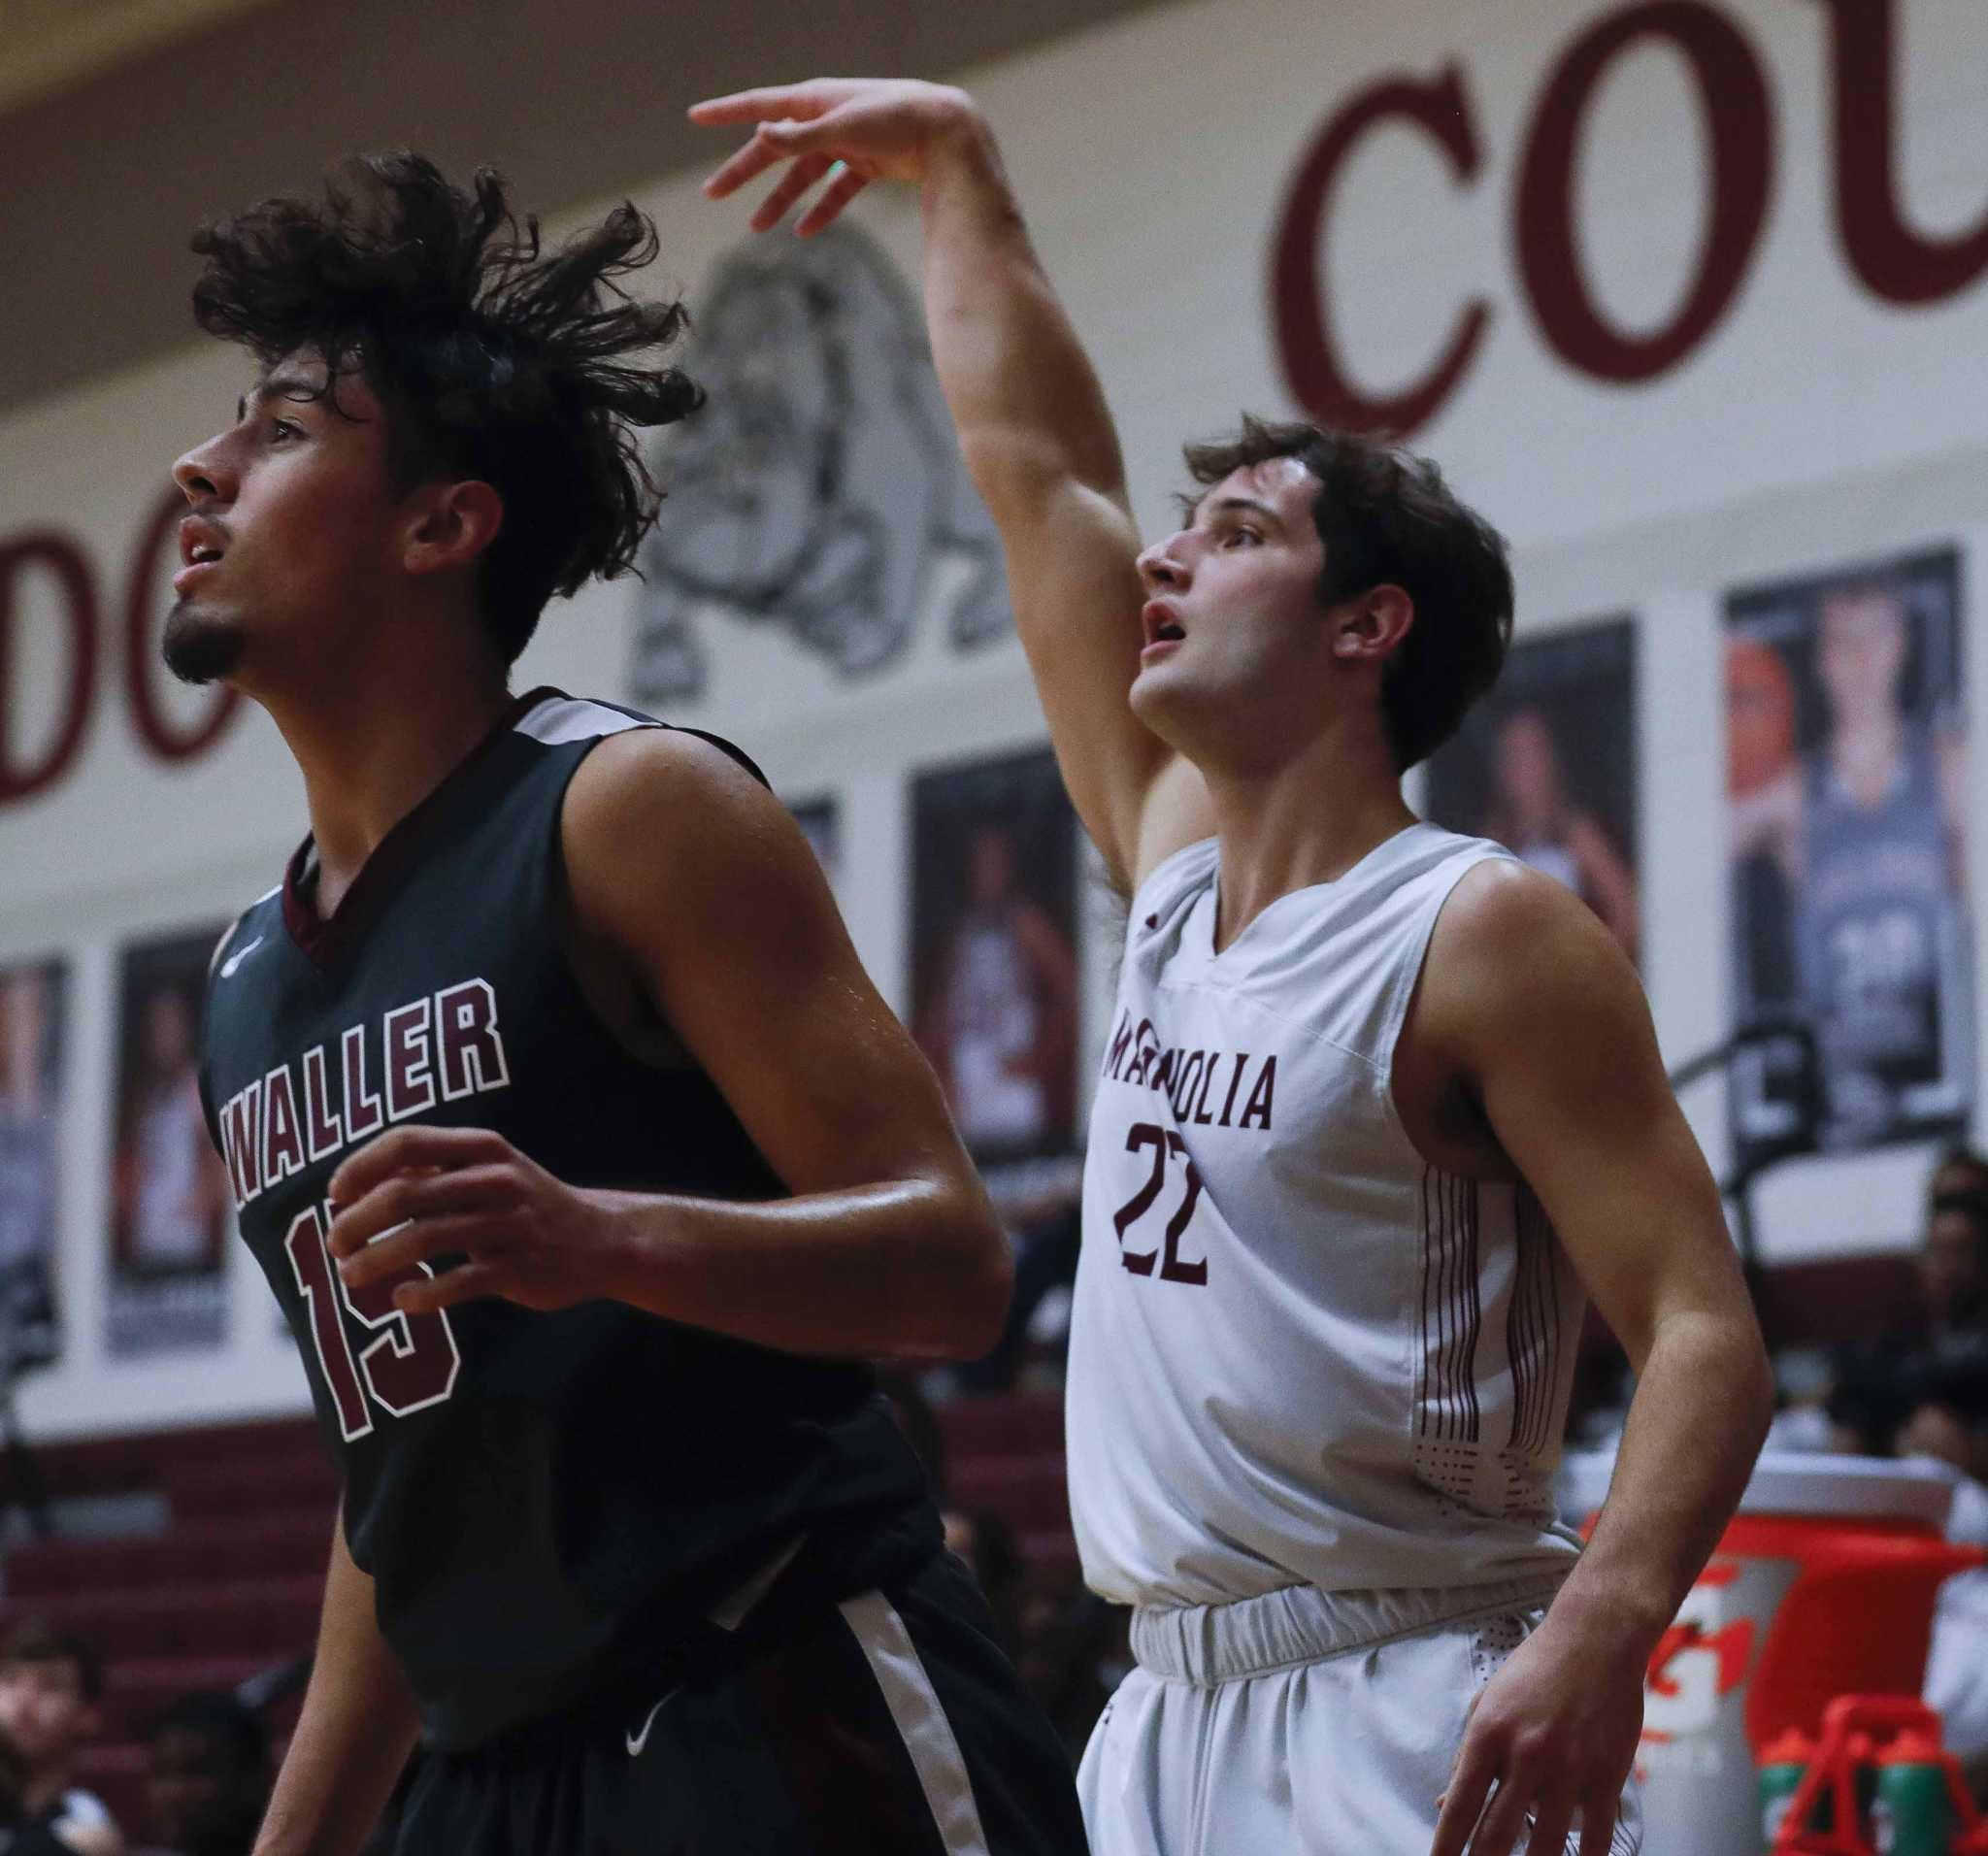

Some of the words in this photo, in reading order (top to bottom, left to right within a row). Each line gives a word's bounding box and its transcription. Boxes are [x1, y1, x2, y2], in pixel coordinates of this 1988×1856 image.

[219, 978, 511, 1211] WALLER
[1103, 1007, 1277, 1131] MAGNOLIA
[1113, 1122, 1209, 1287] 22
[284, 1197, 461, 1443] 15
